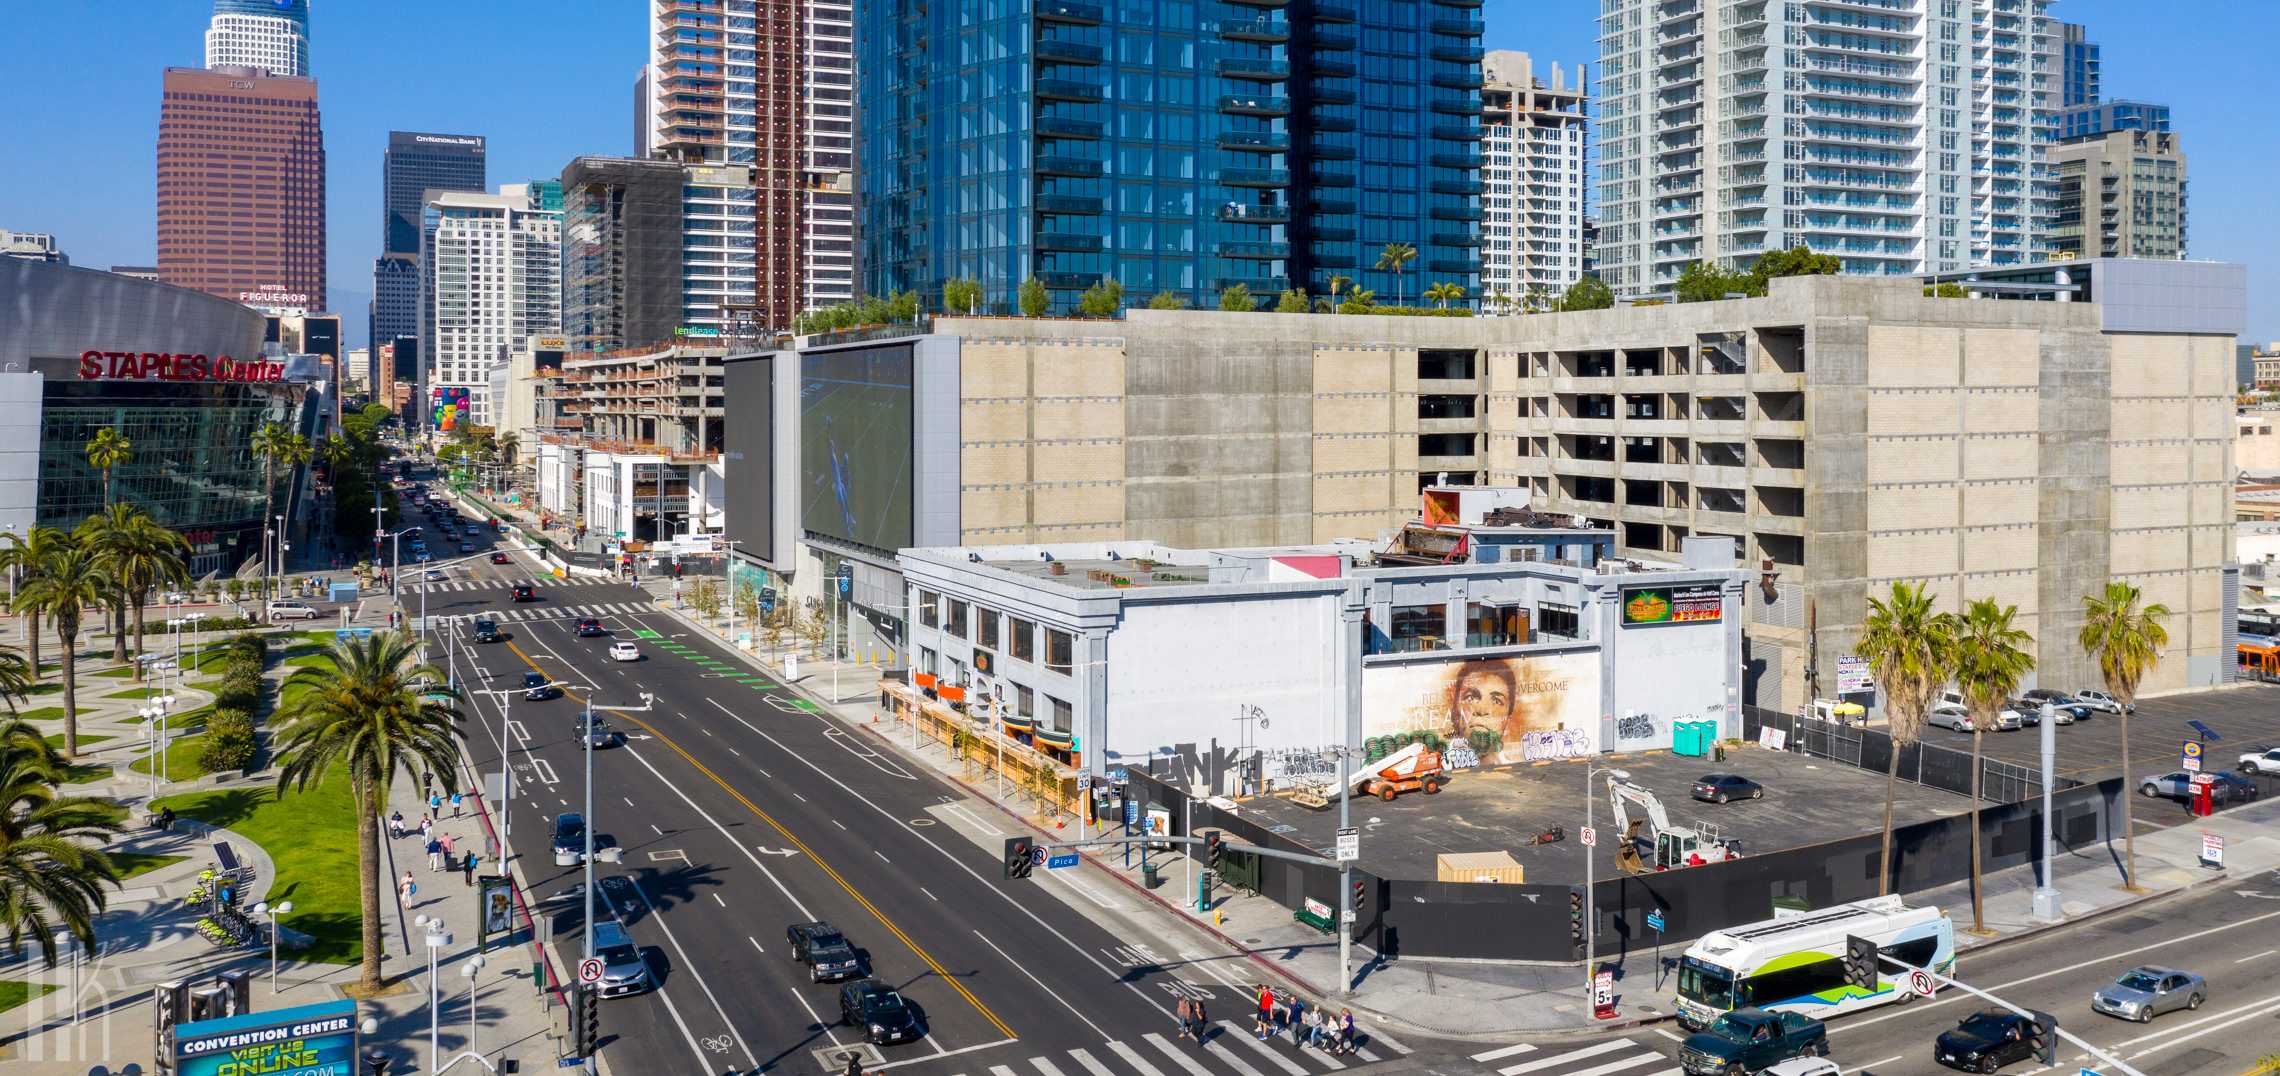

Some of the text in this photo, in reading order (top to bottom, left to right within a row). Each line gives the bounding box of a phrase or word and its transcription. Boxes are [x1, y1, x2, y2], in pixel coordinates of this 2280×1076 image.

[228, 79, 257, 90] TCW
[240, 292, 307, 303] FIGUEROA
[80, 350, 286, 382] STAPLES Center
[1079, 779, 1090, 789] 30
[1156, 980, 1217, 1001] BUS
[184, 1018, 348, 1053] CONVENTION CENTER
[231, 1041, 304, 1060] VISIT US
[217, 1049, 320, 1076] ONLINE
